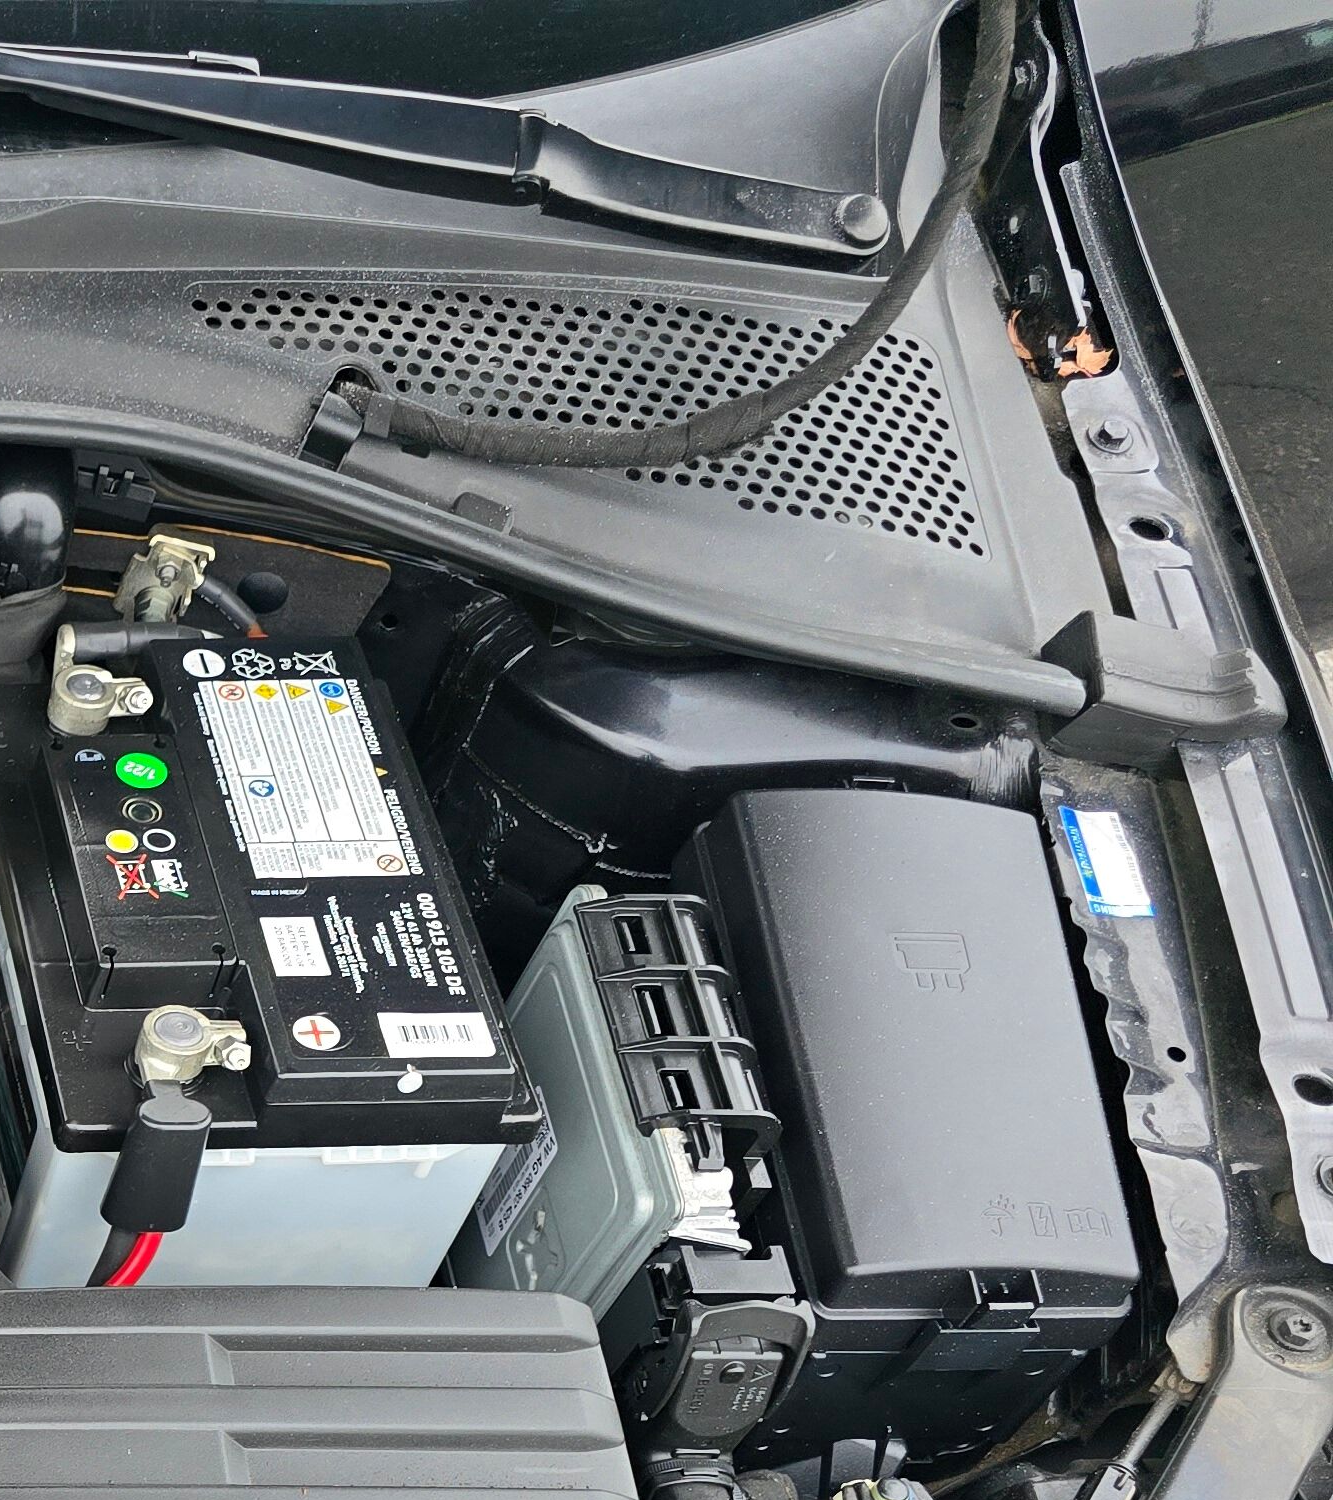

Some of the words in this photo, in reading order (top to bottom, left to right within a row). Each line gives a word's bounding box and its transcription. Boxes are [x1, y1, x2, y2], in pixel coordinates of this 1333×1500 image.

[124, 761, 156, 780] 1/22
[346, 679, 382, 755] DANGER/POISON
[384, 789, 424, 876] PELIGRO/VENENO
[399, 902, 415, 919] 12V
[417, 893, 439, 919] 000
[426, 920, 448, 946] 915
[435, 948, 458, 974] 105
[444, 976, 466, 996] DE
